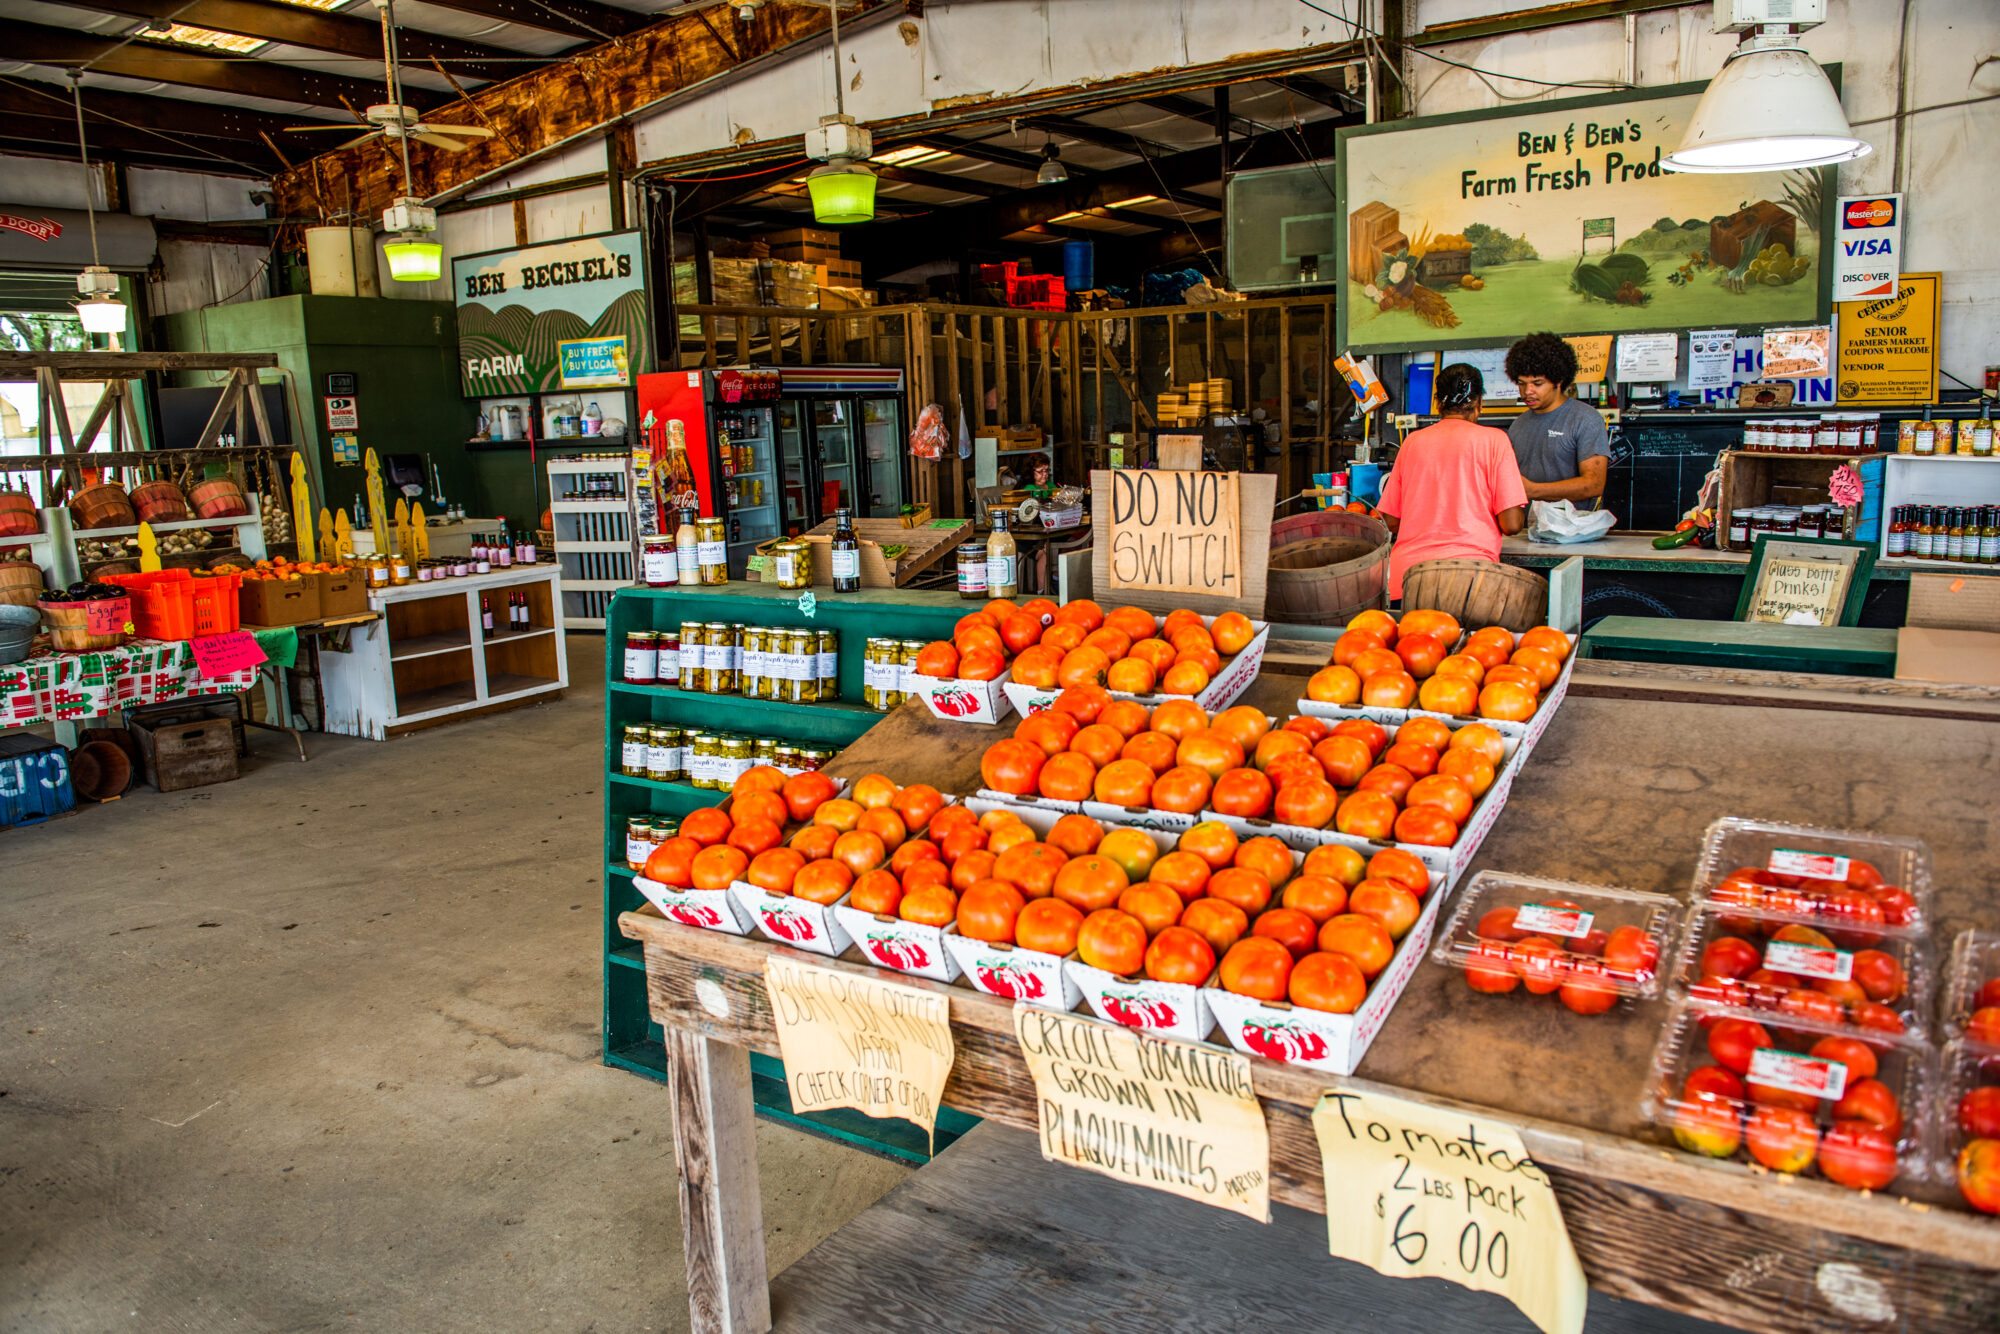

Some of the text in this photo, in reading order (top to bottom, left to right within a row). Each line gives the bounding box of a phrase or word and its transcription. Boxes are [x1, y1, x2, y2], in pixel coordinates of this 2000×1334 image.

[1461, 170, 1517, 199] Farm
[1847, 208, 1892, 220] MasterCard
[8, 217, 47, 237] DOOR
[1841, 238, 1892, 256] VISA
[465, 253, 632, 298] BEN BECNEL'S
[1842, 273, 1890, 283] DISCOVER
[1848, 337, 1926, 347] FARMERS MARKET
[1864, 326, 1908, 337] SENIOR
[568, 346, 615, 358] BUY FRESH
[1844, 346, 1930, 356] COUPONS WELCOME
[467, 354, 525, 378] FARM
[569, 359, 617, 371] BUY LOCAL
[1843, 363, 1885, 372] VENDOR
[1113, 471, 1228, 526] DO NO
[1768, 561, 1801, 577] Glass
[1207, 663, 1256, 712] OMATOES
[1020, 1011, 1125, 1072] CREOLE
[796, 1071, 853, 1107] CHECK
[898, 1080, 912, 1107] OF
[1051, 1061, 1202, 1123] GROWN IN
[1043, 1098, 1218, 1194] PLAQUEMINES
[1324, 1094, 1552, 1189] Tomatoe
[1223, 1169, 1264, 1198] PARISH
[1393, 1154, 1416, 1190] 2
[1423, 1177, 1455, 1200] LBS
